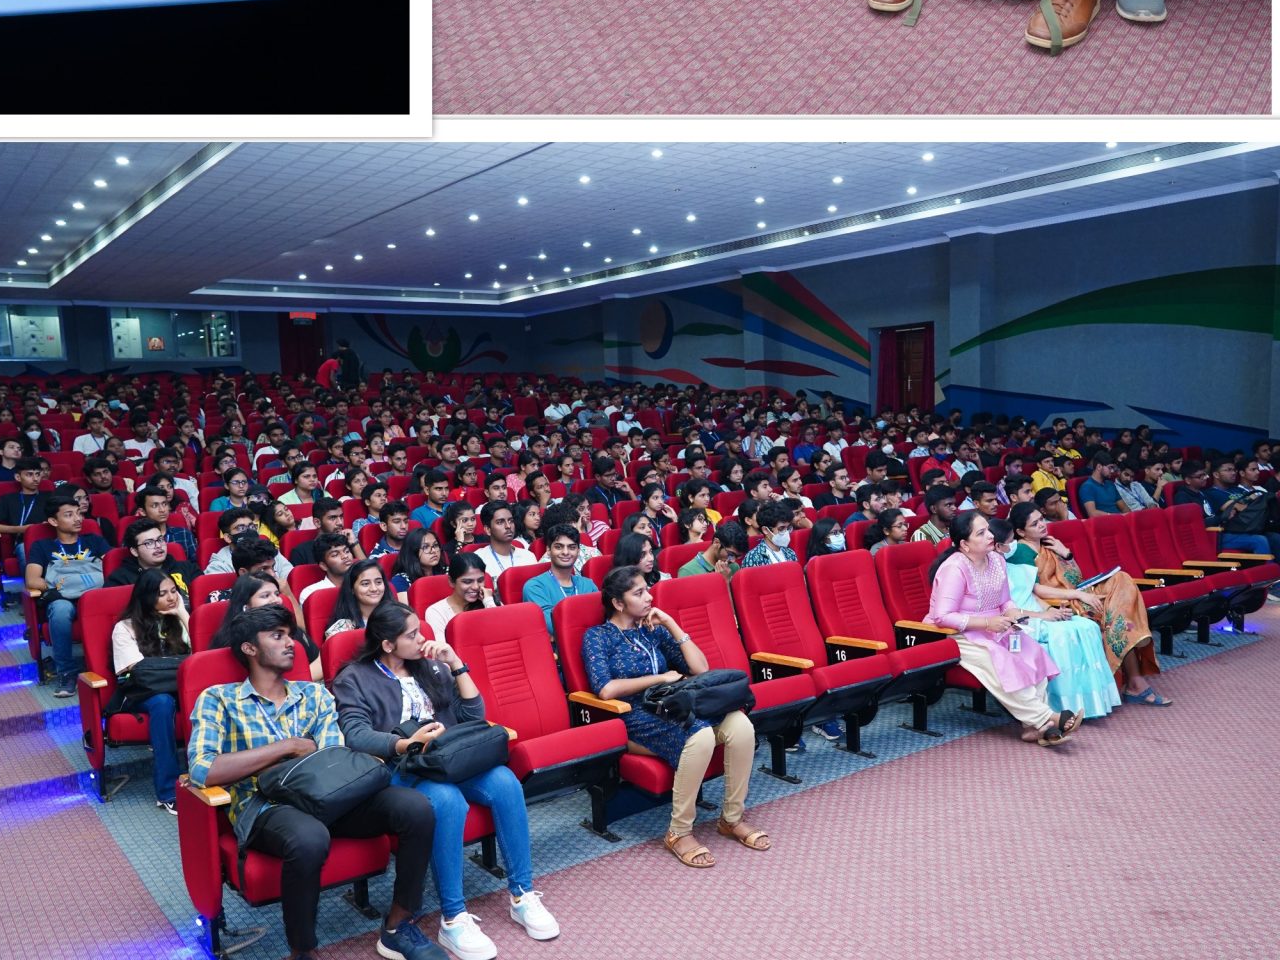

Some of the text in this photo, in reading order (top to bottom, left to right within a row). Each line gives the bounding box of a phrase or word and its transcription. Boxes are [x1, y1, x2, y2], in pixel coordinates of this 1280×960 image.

[905, 634, 916, 647] 17
[835, 649, 847, 662] 16
[761, 667, 773, 680] 15
[580, 708, 591, 724] 13
